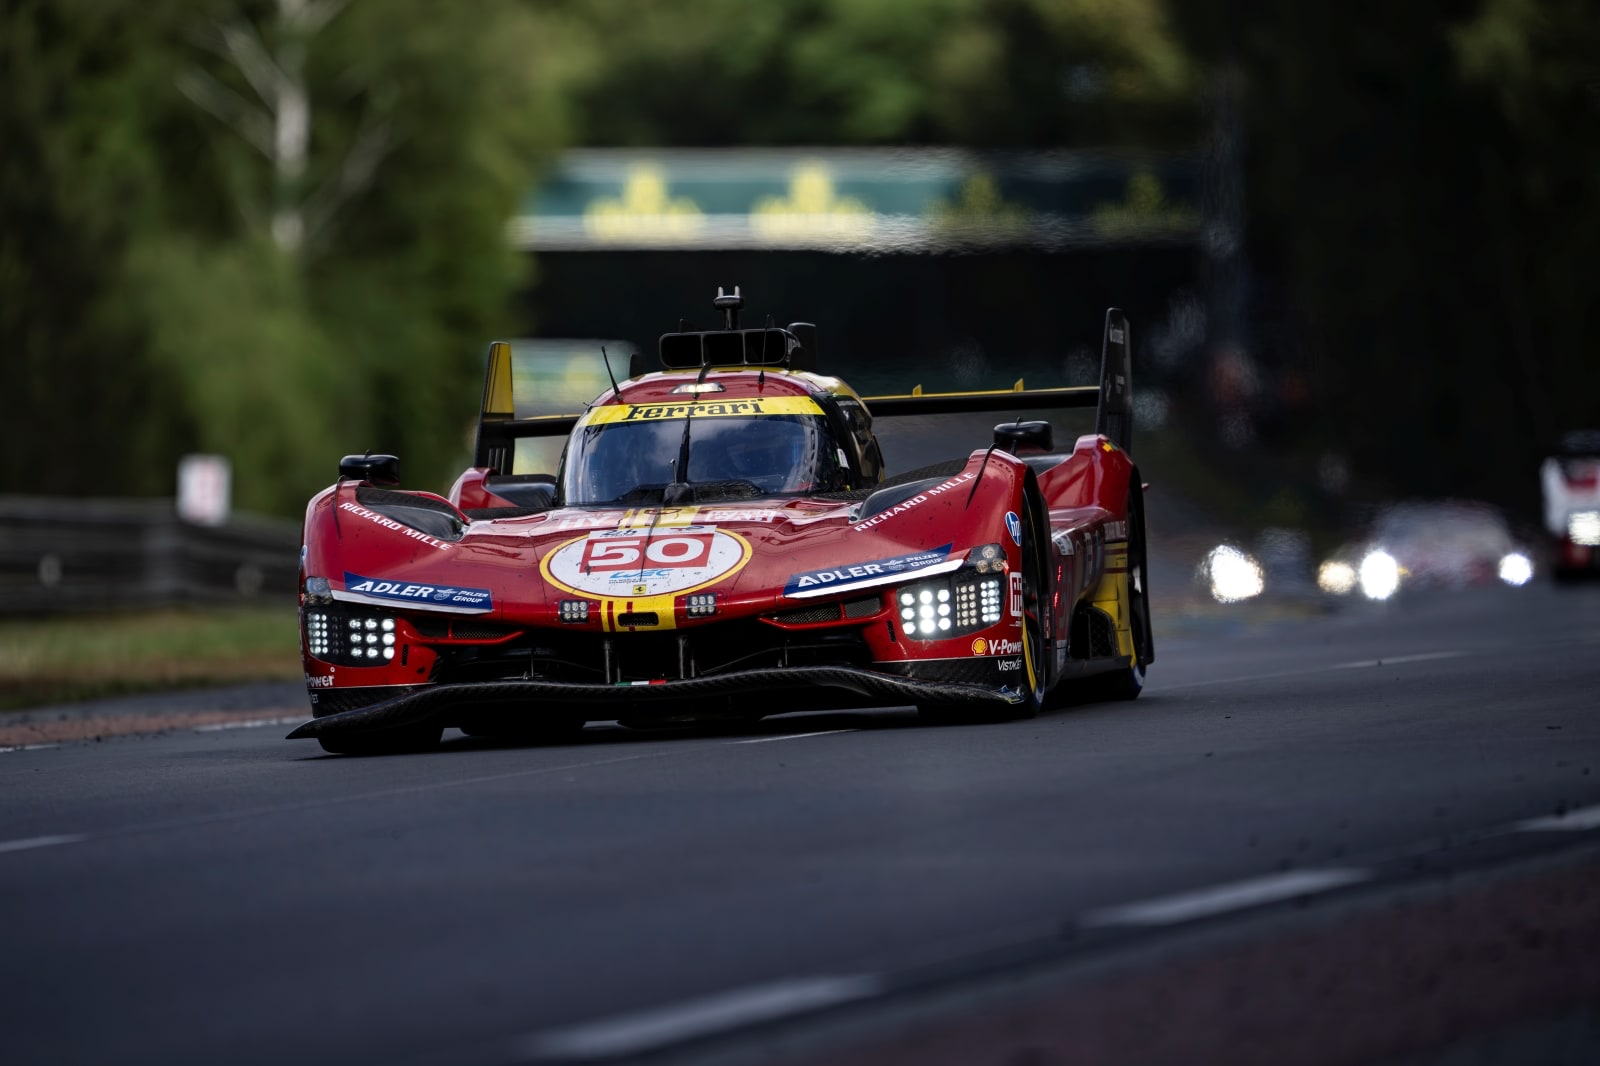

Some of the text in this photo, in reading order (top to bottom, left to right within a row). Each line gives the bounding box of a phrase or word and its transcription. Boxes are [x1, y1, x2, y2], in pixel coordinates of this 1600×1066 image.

[622, 399, 765, 421] Ferrari
[854, 472, 977, 531] RICHARD MILLE
[339, 502, 453, 551] RICHARD MILLE
[587, 537, 705, 567] 50
[910, 557, 943, 567] GROUP
[798, 563, 885, 588] ADLER
[351, 580, 434, 598] ADLER
[452, 595, 483, 603] GROUP
[457, 590, 489, 598] PELZER
